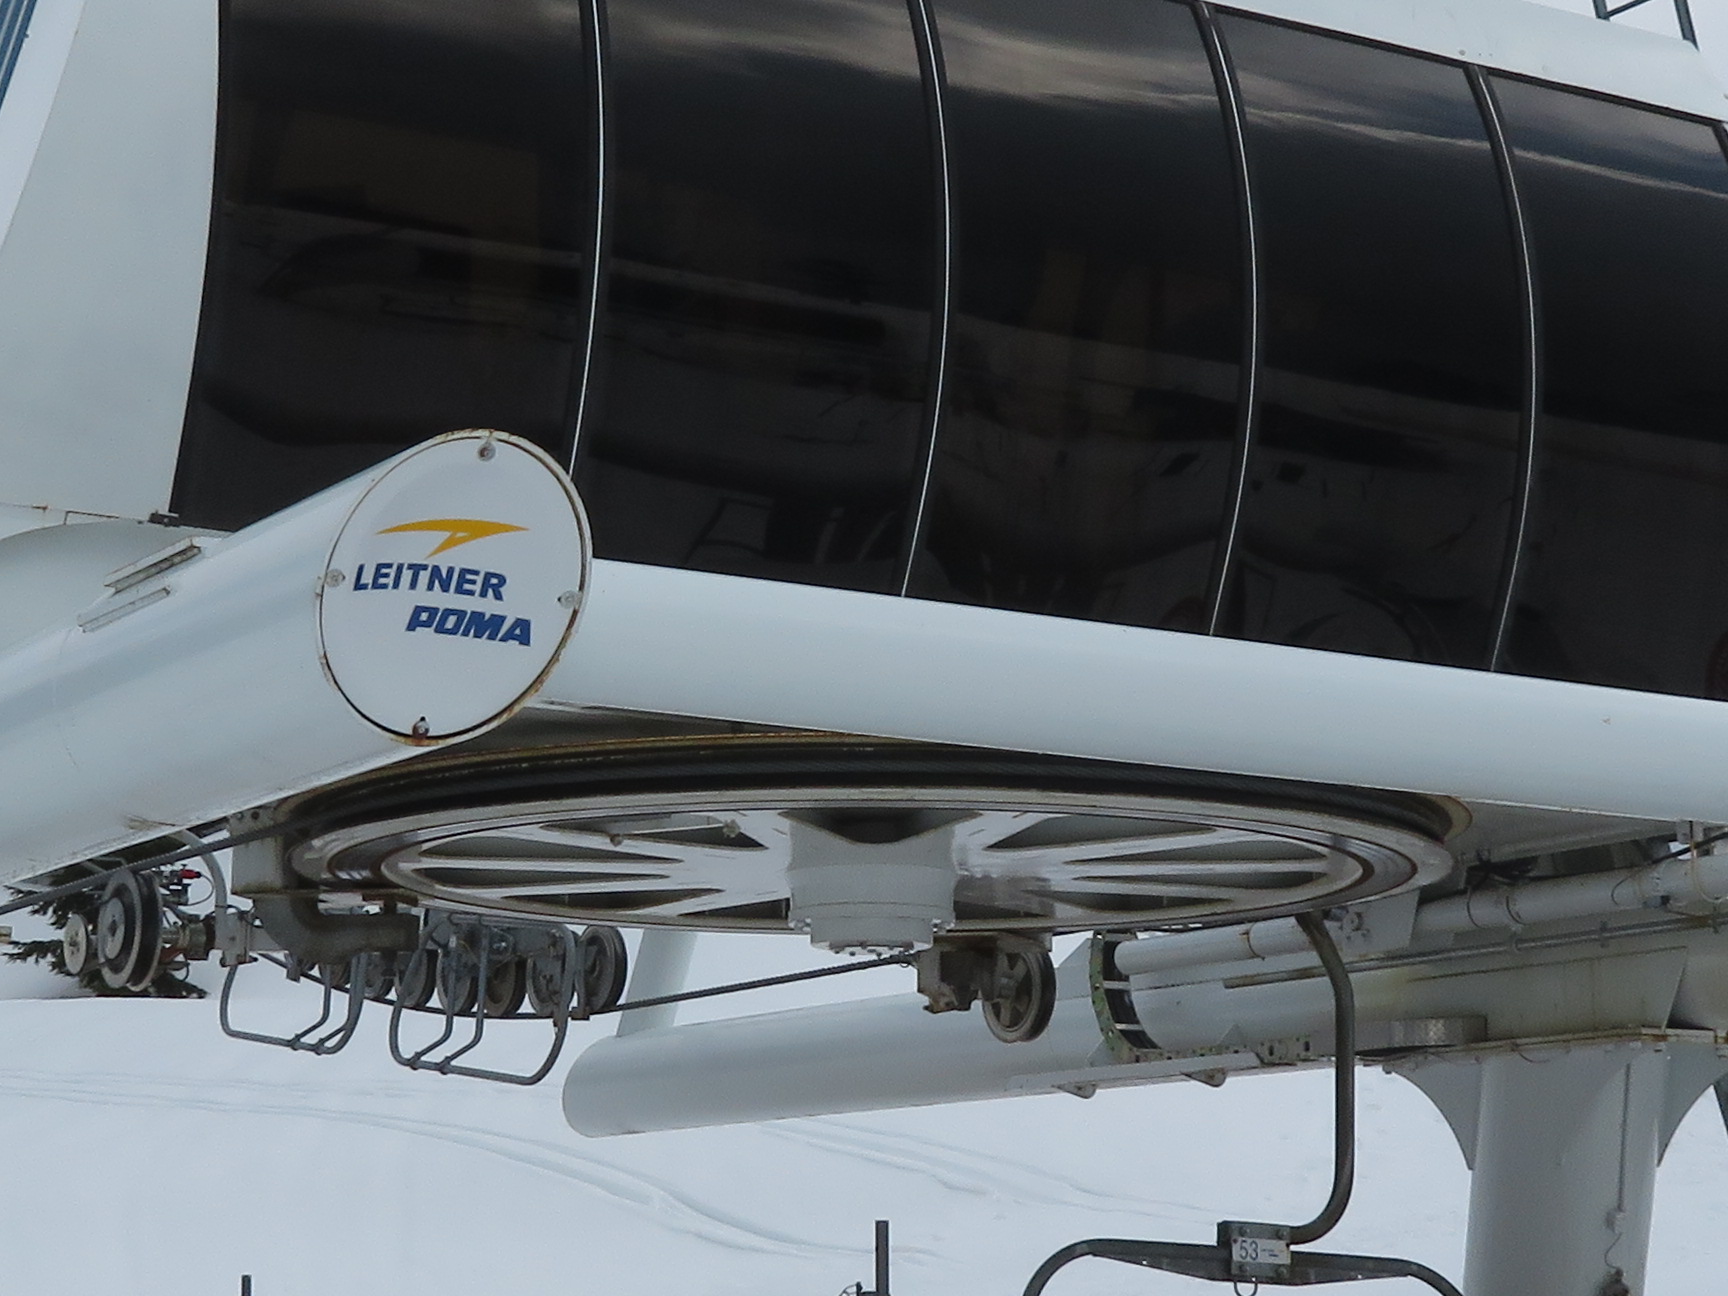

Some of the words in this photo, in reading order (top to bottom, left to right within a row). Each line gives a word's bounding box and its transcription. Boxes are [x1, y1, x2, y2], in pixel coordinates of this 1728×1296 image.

[352, 562, 507, 602] LEITNER
[405, 604, 532, 647] POMA
[1239, 1239, 1259, 1261] 53
